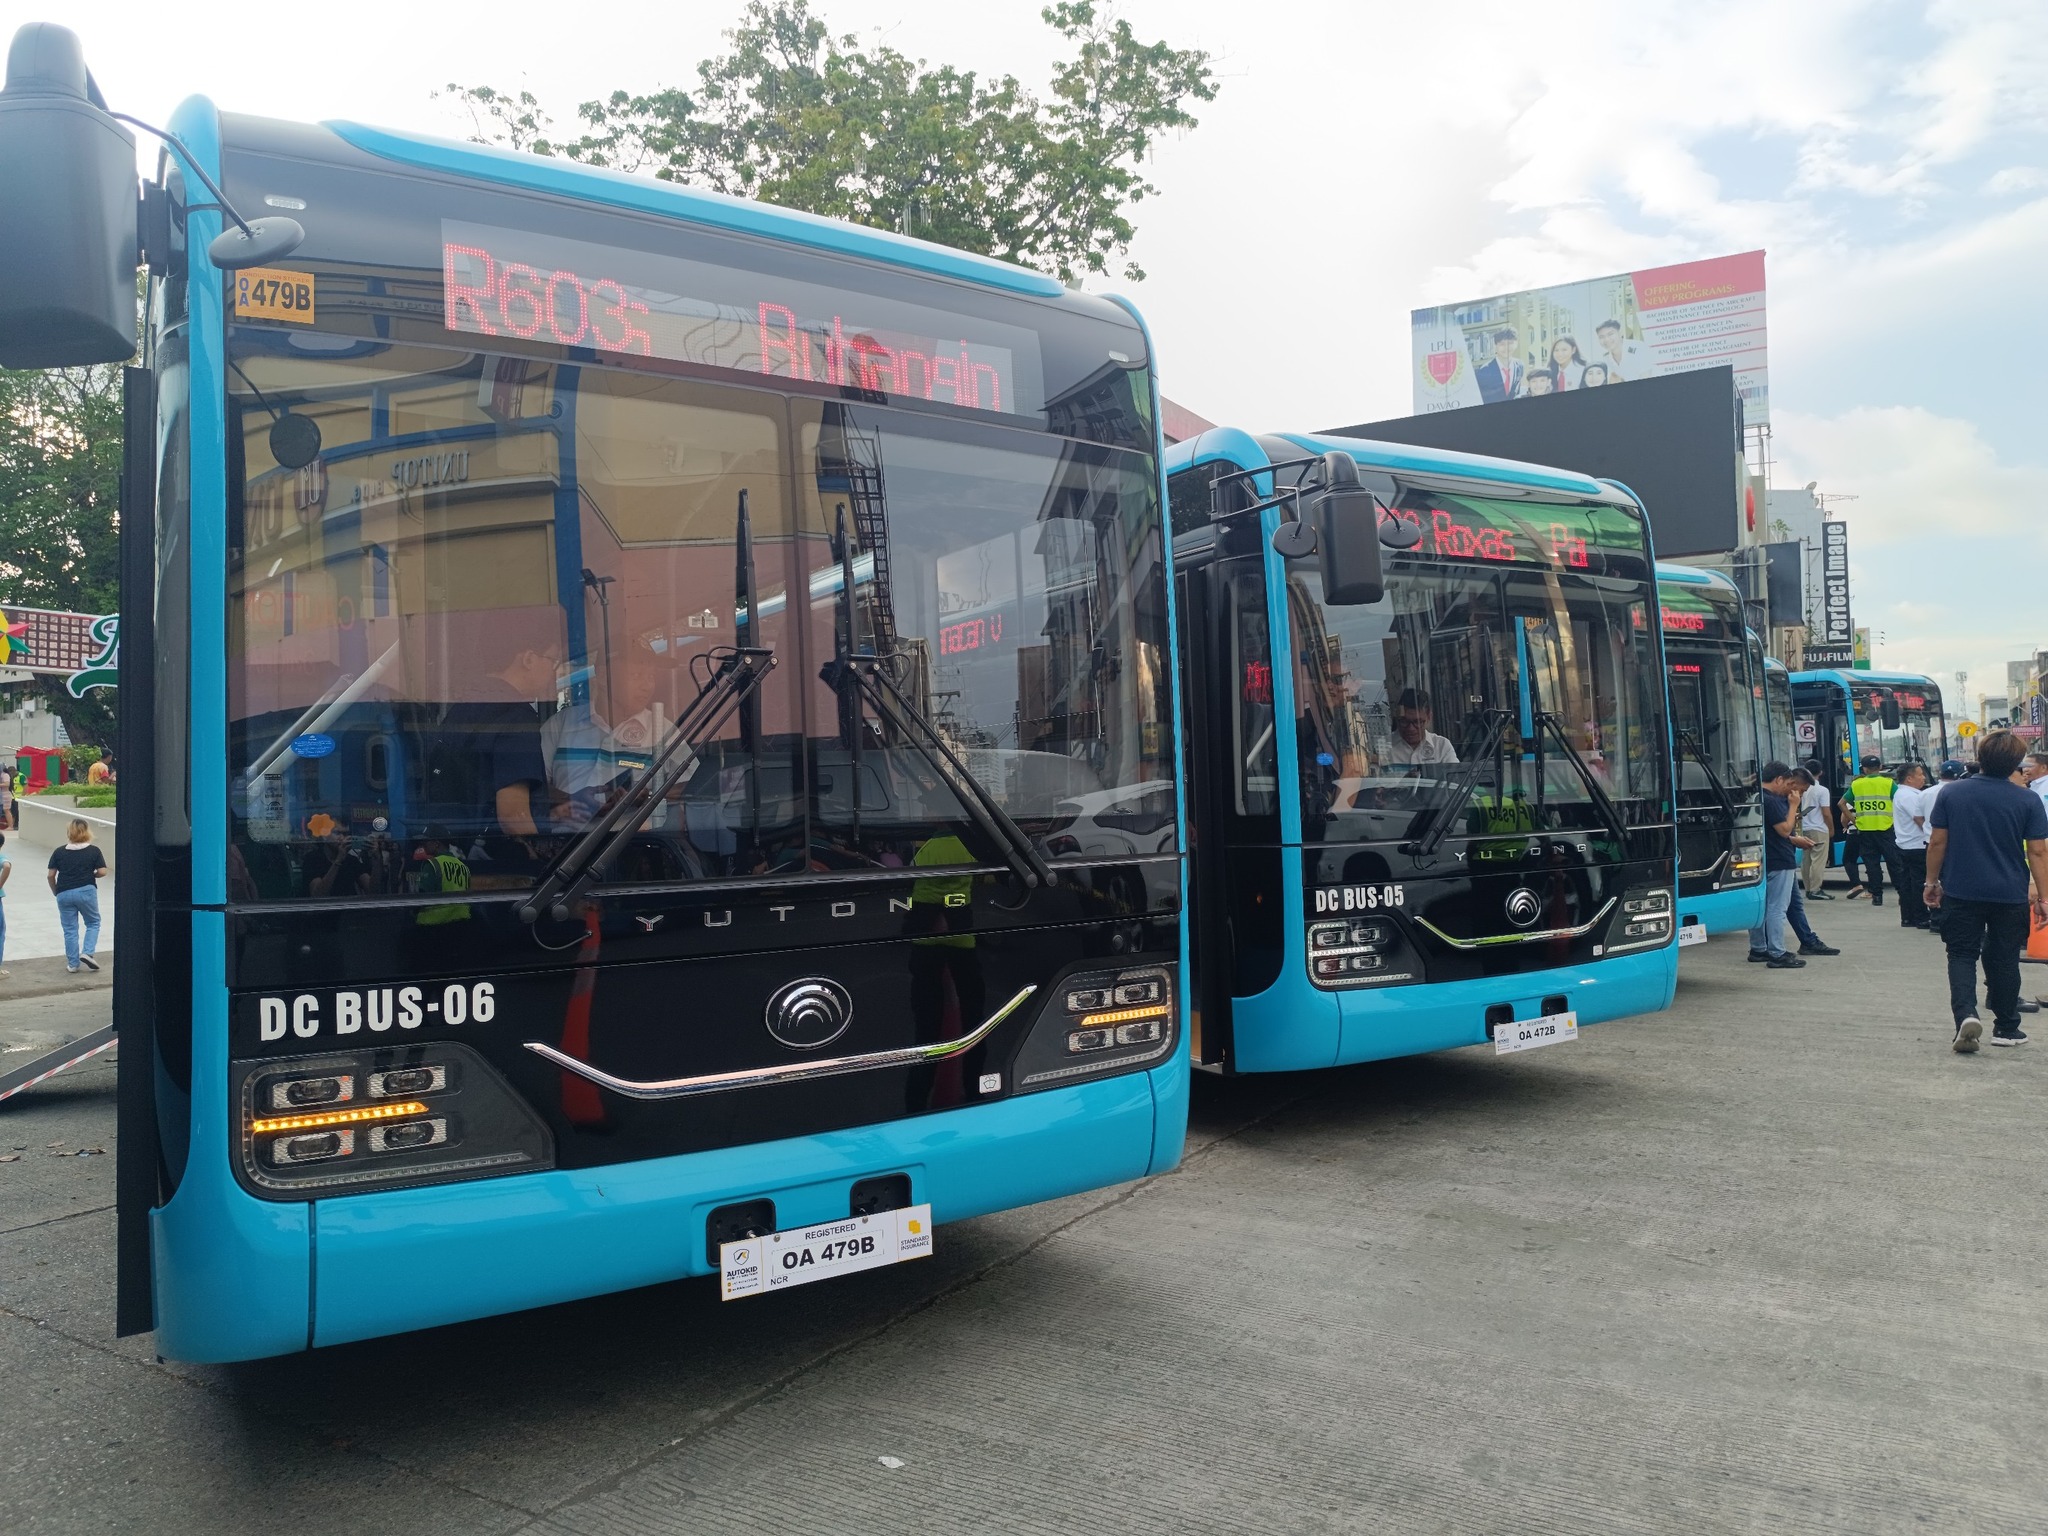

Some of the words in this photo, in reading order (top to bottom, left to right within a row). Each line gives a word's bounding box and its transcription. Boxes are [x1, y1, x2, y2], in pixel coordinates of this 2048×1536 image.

[251, 278, 311, 311] 479B
[1644, 281, 1696, 296] OFFERING
[1644, 295, 1669, 306] NEW
[1672, 284, 1736, 301] PROGRAMS:
[1646, 309, 1679, 319] BACHELOR
[1689, 302, 1715, 312] SCIENCE
[1726, 296, 1756, 306] AIRCRAFT
[1656, 311, 1701, 323] MAINTENANCE
[1702, 304, 1745, 317] TECHNOLOGY
[1655, 326, 1687, 336] BACHELOR
[1699, 321, 1725, 330] SCIENCE
[1430, 340, 1453, 352] LPU
[1658, 344, 1690, 354] BACHELOR
[1701, 340, 1727, 348] SCIENCE
[1682, 348, 1706, 357] AIRLINE
[1707, 341, 1752, 353] MANAGEMENT
[1664, 362, 1696, 372] BACHELOR
[1708, 358, 1733, 366] SCIENCE
[1427, 400, 1460, 412] DAVAO
[1431, 509, 1516, 561] Roxas
[1825, 523, 1847, 577] Image
[1661, 606, 1704, 630] Roxas
[1827, 578, 1848, 641] Perfect
[1802, 652, 1853, 663] FUJIFILM
[1454, 843, 1587, 862] YUTONG
[1315, 889, 1339, 913] DC
[1343, 885, 1405, 911] BUS-05
[635, 893, 966, 932] YUTONG
[260, 994, 320, 1041] DC
[336, 982, 496, 1035] BUS-06
[1534, 1025, 1556, 1037] 472B
[805, 1223, 856, 1240] REGISTERED
[900, 1234, 930, 1246] STANDARD
[782, 1249, 815, 1269] OA
[821, 1236, 875, 1261] 479B
[900, 1240, 930, 1251] INSURANCE
[726, 1265, 758, 1278] AUTOKID
[770, 1275, 789, 1286] NCR
